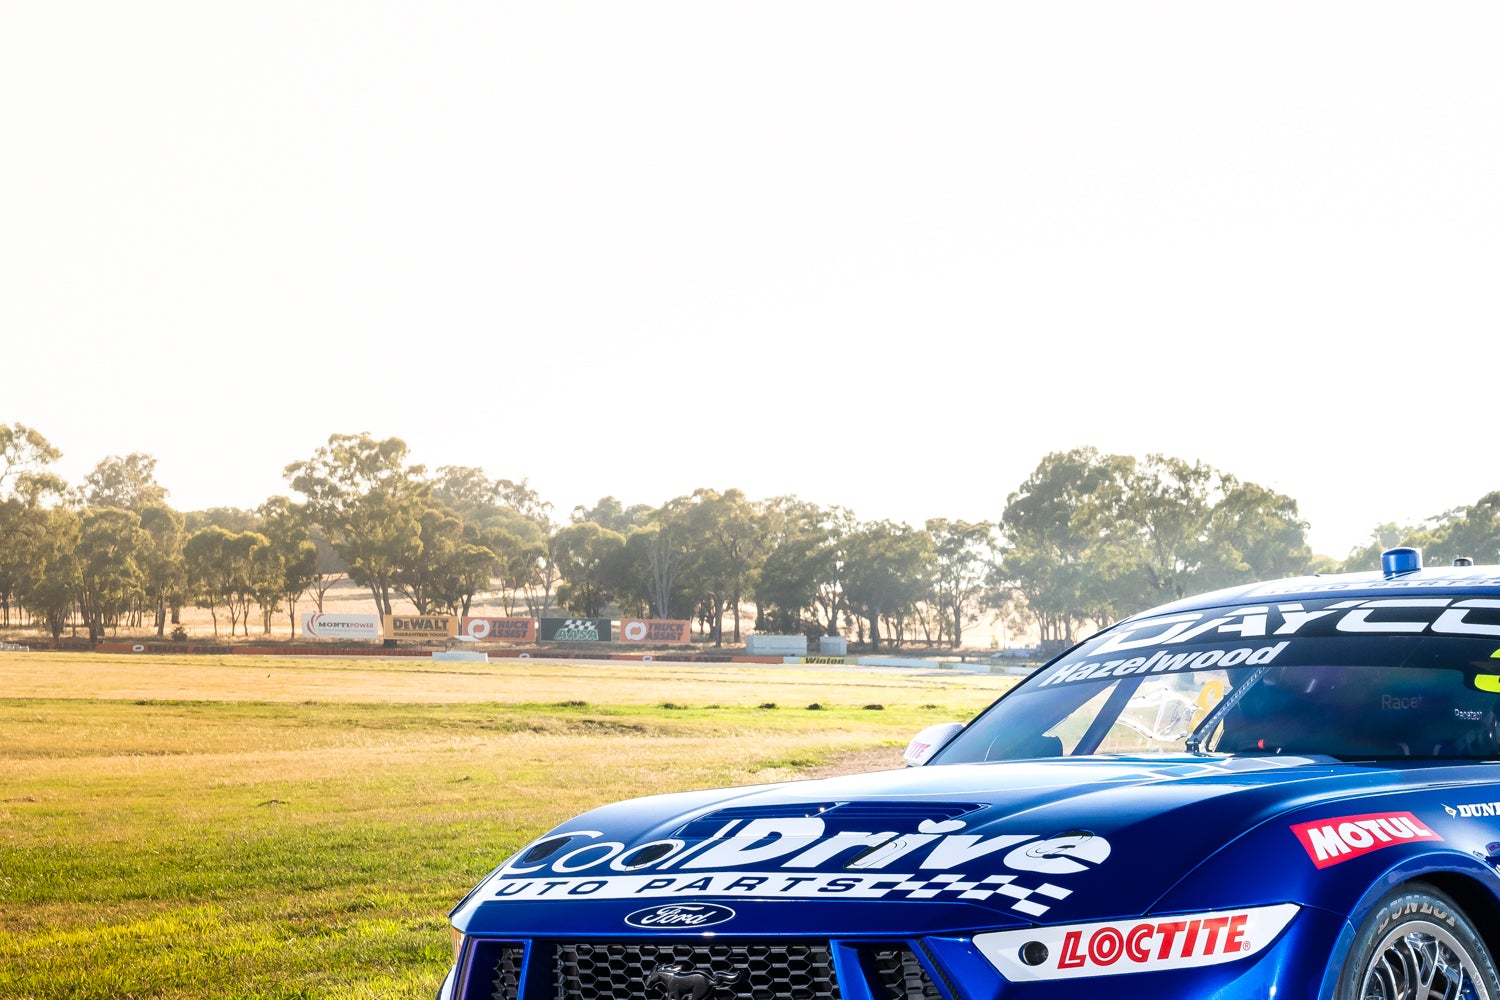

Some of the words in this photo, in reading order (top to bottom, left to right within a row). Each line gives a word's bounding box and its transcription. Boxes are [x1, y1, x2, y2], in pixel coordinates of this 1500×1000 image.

[489, 629, 527, 638] ASSIST
[491, 620, 530, 629] TRUCK
[555, 629, 599, 641] AASA
[648, 623, 685, 632] TRUCK
[645, 631, 683, 641] ASSIST
[1038, 642, 1291, 687] Hazelwood
[503, 817, 1112, 874] CoolDrive
[1307, 816, 1433, 861] MOTUL
[494, 880, 609, 897] UTO
[634, 876, 863, 895] PARTS
[640, 905, 717, 927] Ford
[1057, 914, 1248, 969] LOCTITE
